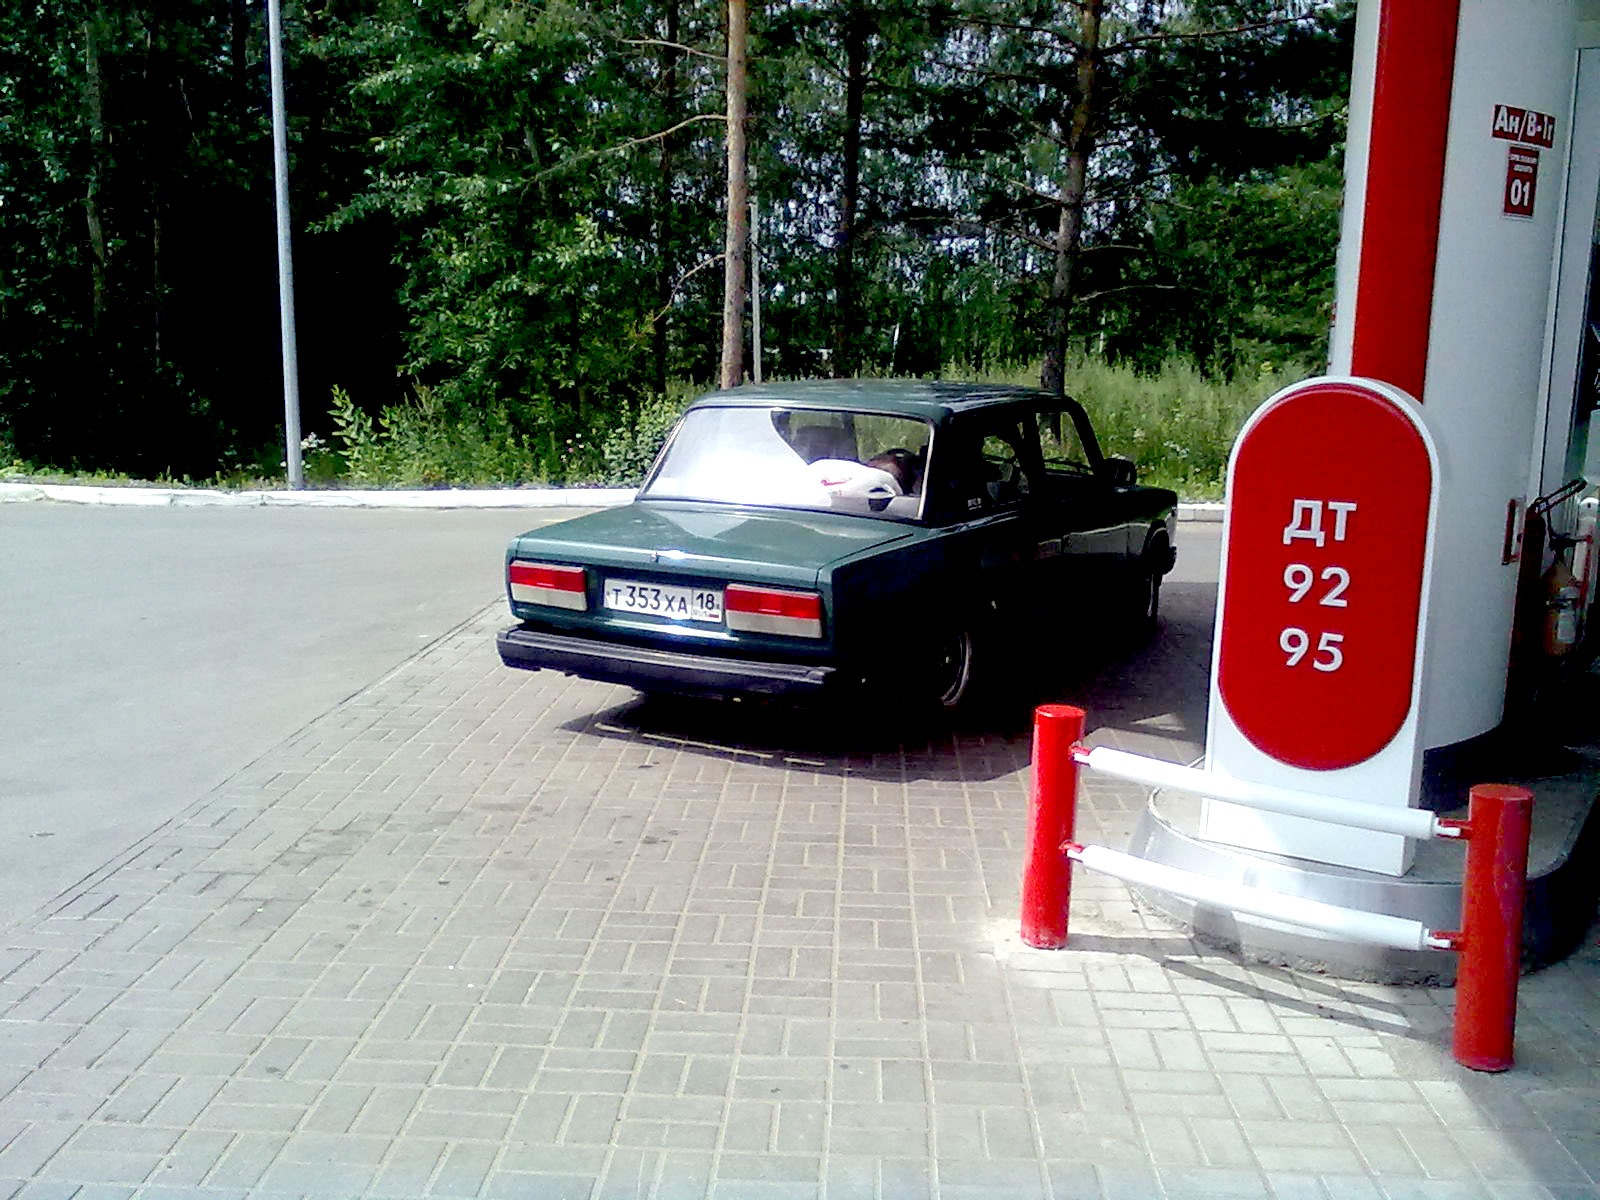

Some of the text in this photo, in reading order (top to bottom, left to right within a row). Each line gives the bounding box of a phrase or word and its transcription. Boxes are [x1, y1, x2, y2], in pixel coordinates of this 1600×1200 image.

[1510, 178, 1530, 207] 01
[1282, 498, 1358, 548] ДТ
[696, 592, 715, 611] 18
[1283, 563, 1350, 608] 92
[1279, 627, 1344, 672] 95
